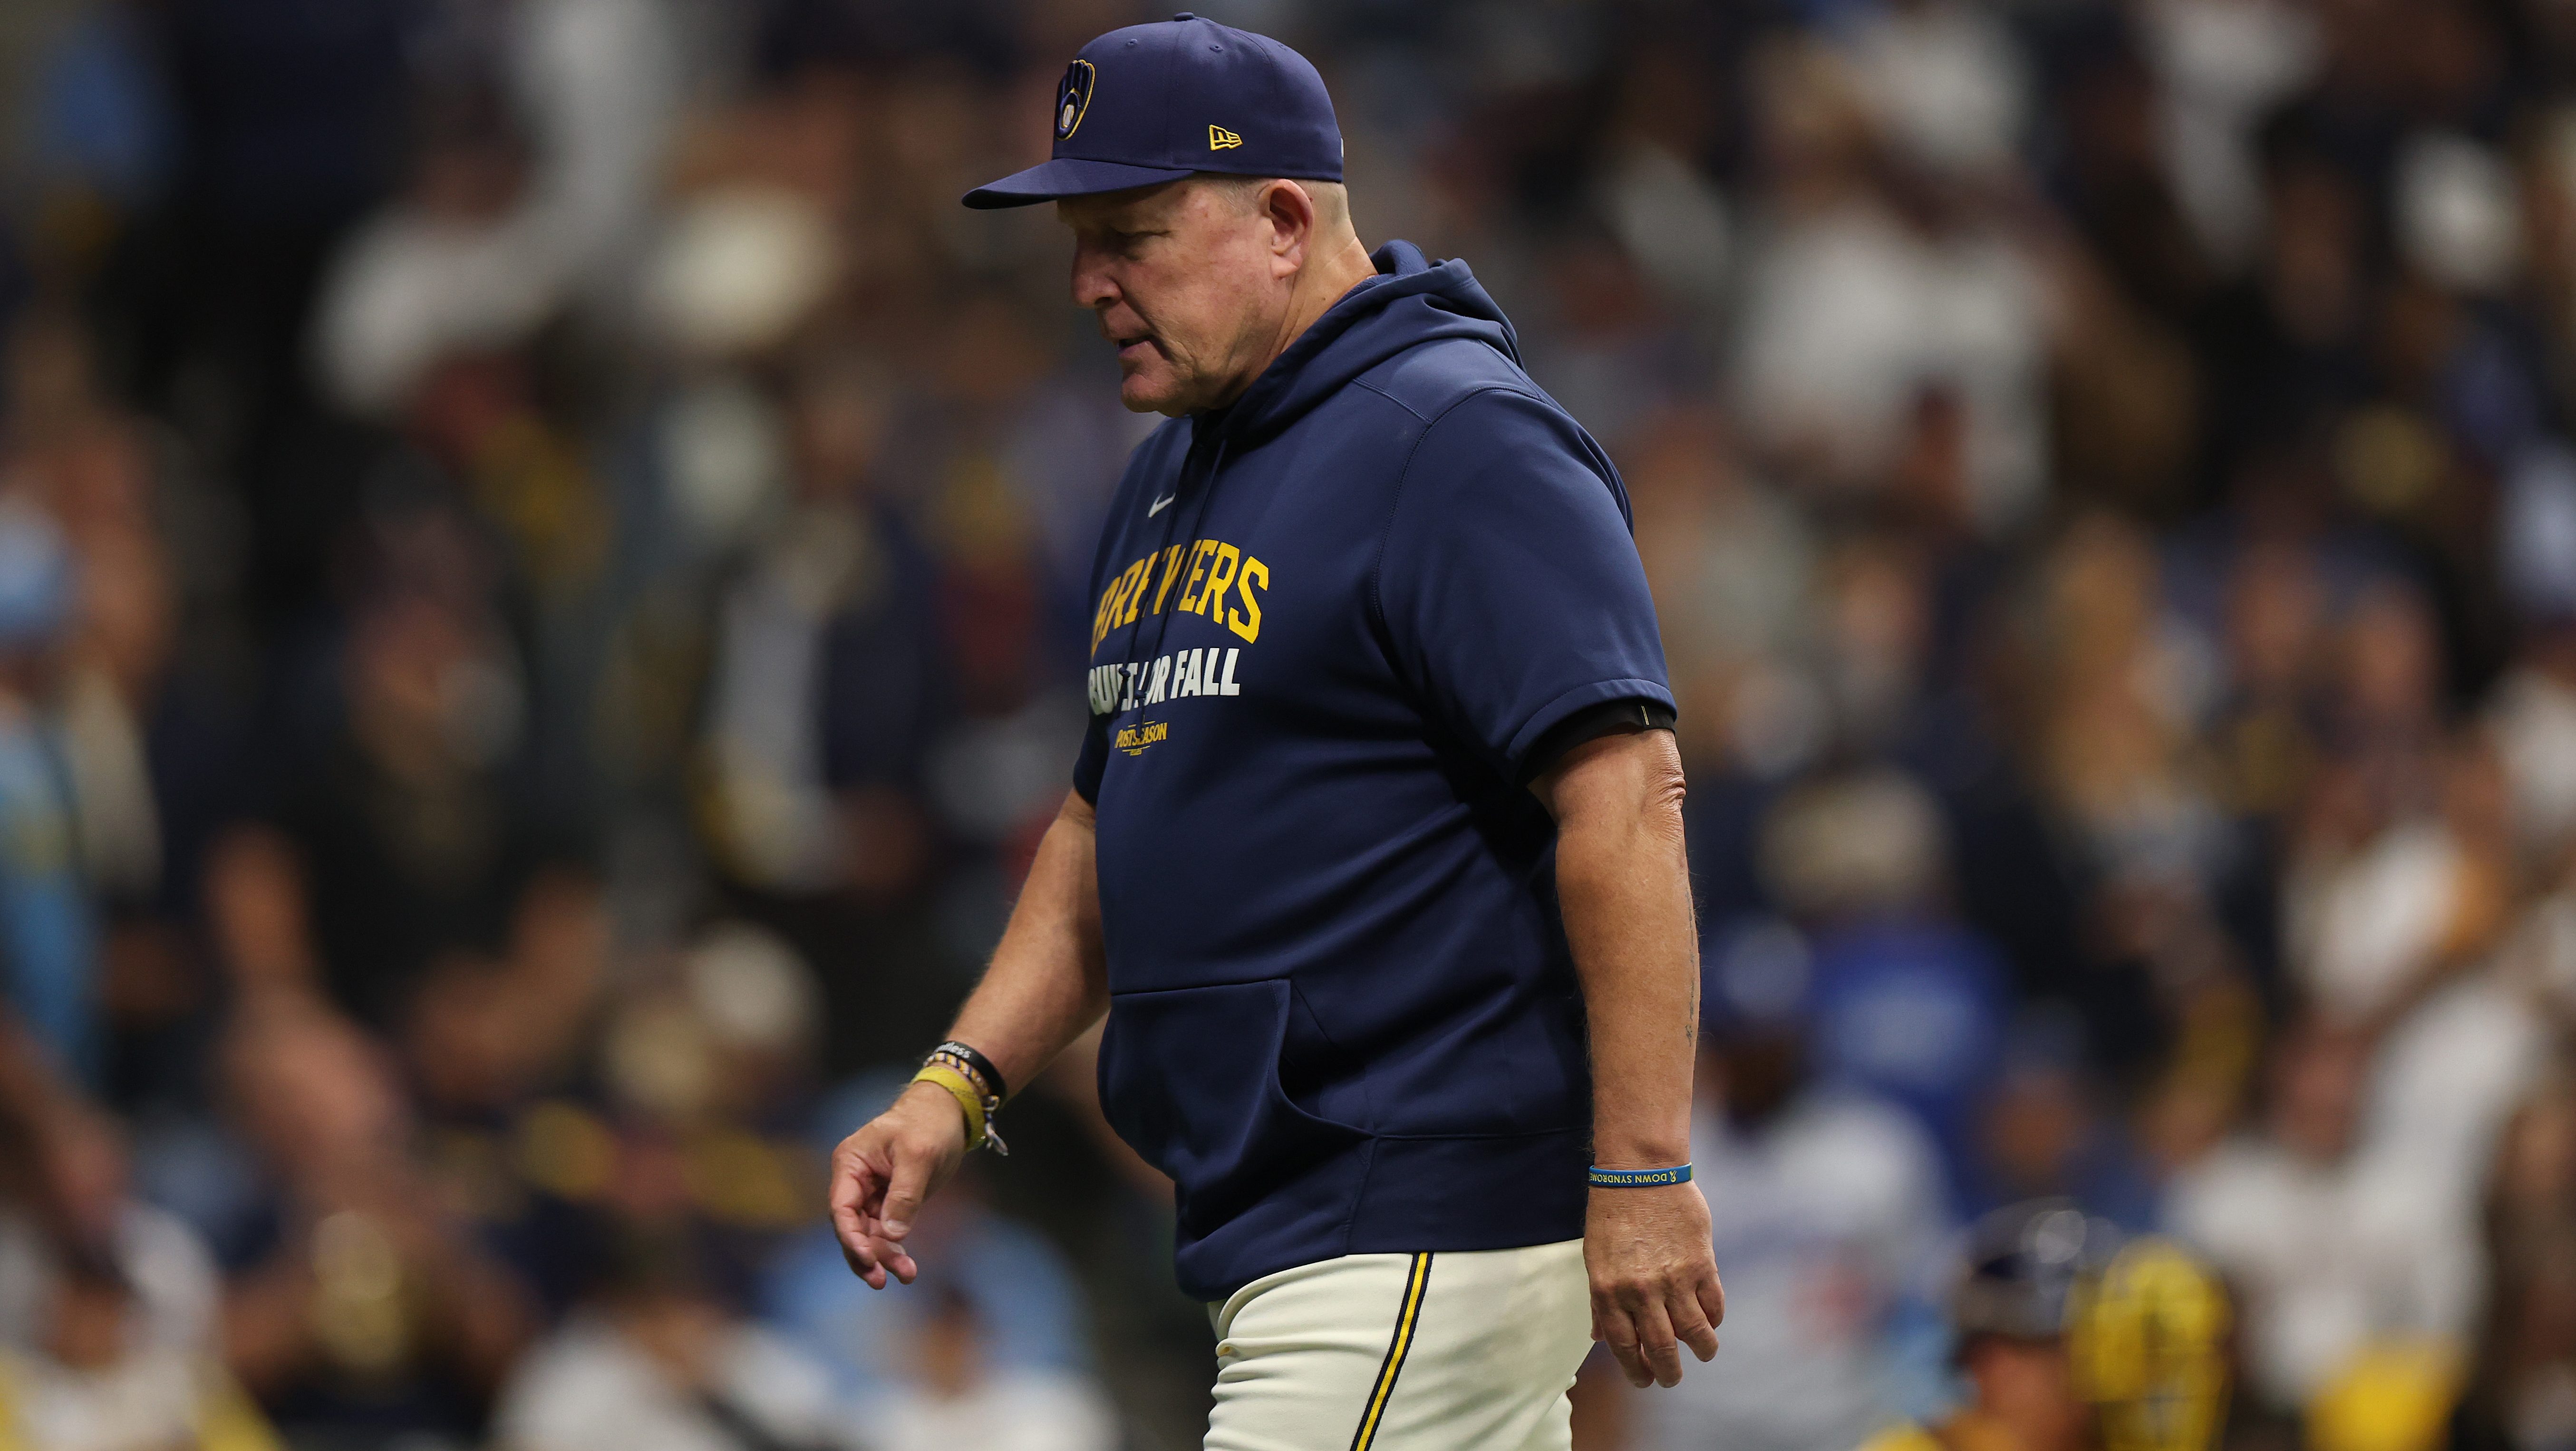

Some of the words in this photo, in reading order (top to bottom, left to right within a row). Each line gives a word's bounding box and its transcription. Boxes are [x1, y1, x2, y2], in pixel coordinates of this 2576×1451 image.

[1170, 648, 1240, 699] FALL
[1114, 722, 1168, 749] POSTSASON
[1635, 1172, 1667, 1183] DOWN
